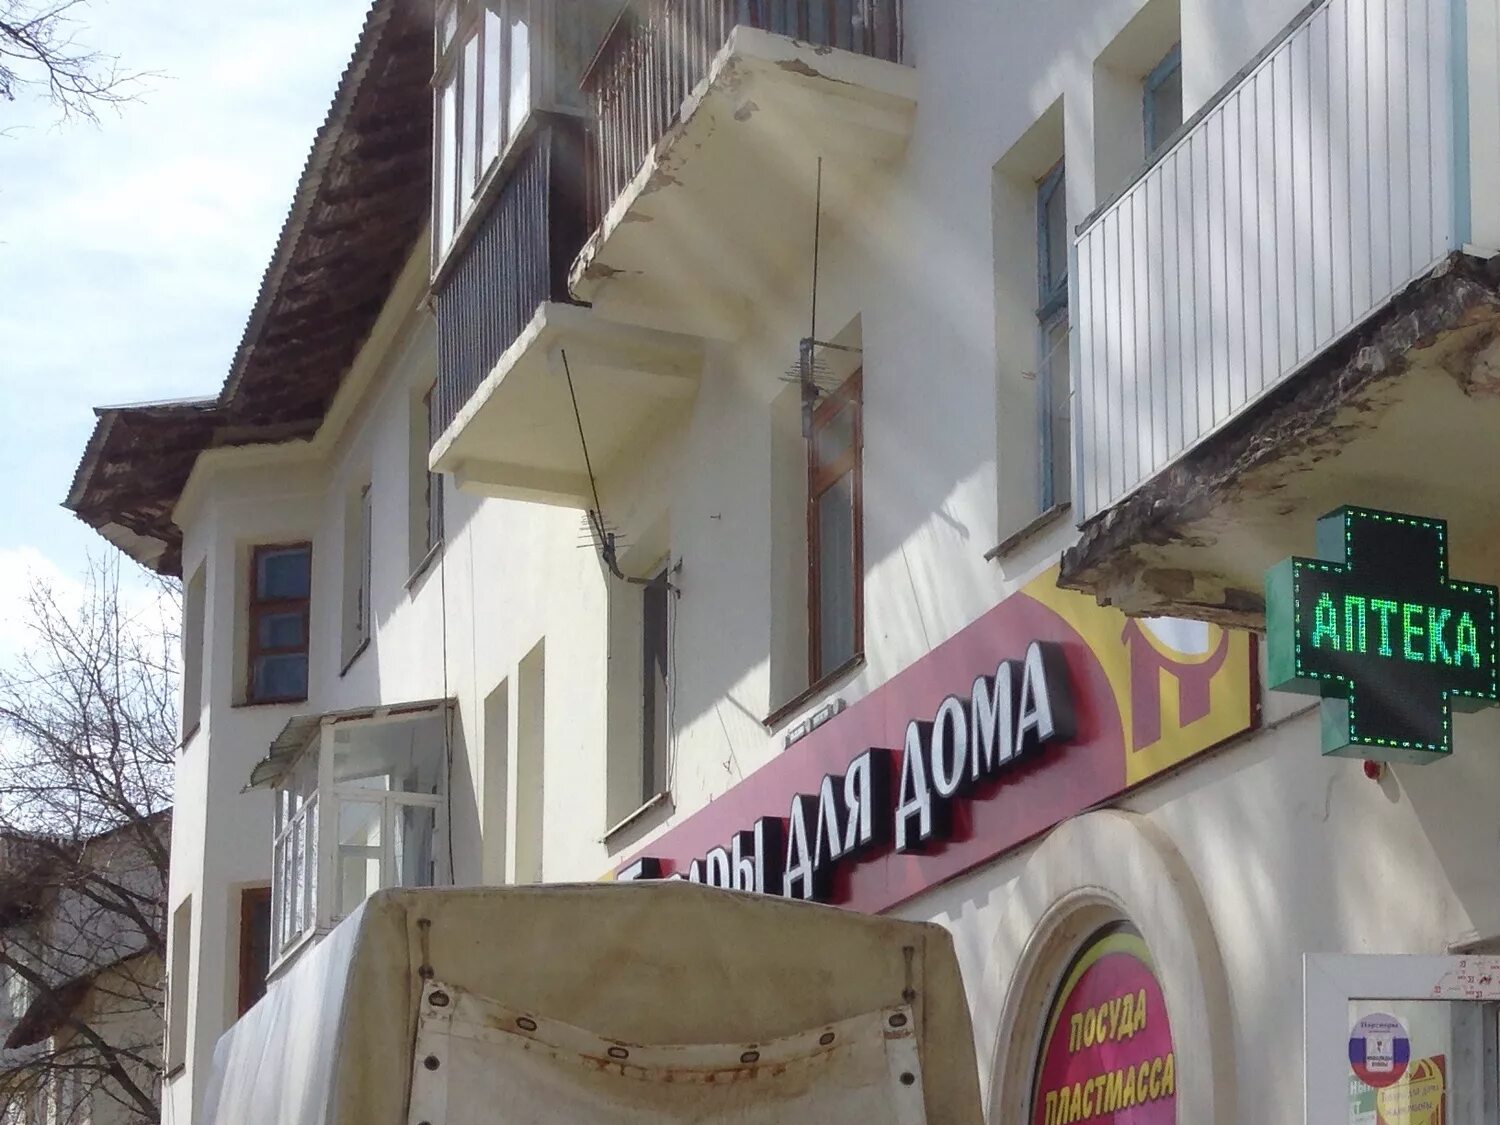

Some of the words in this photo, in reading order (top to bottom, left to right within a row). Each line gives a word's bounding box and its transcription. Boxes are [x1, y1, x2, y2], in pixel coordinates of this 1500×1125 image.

[1313, 591, 1480, 669] АПТЕКА
[783, 749, 873, 900] ДЛЯ
[896, 640, 1055, 850] ДОМА
[1069, 989, 1147, 1055] ПОСУДА
